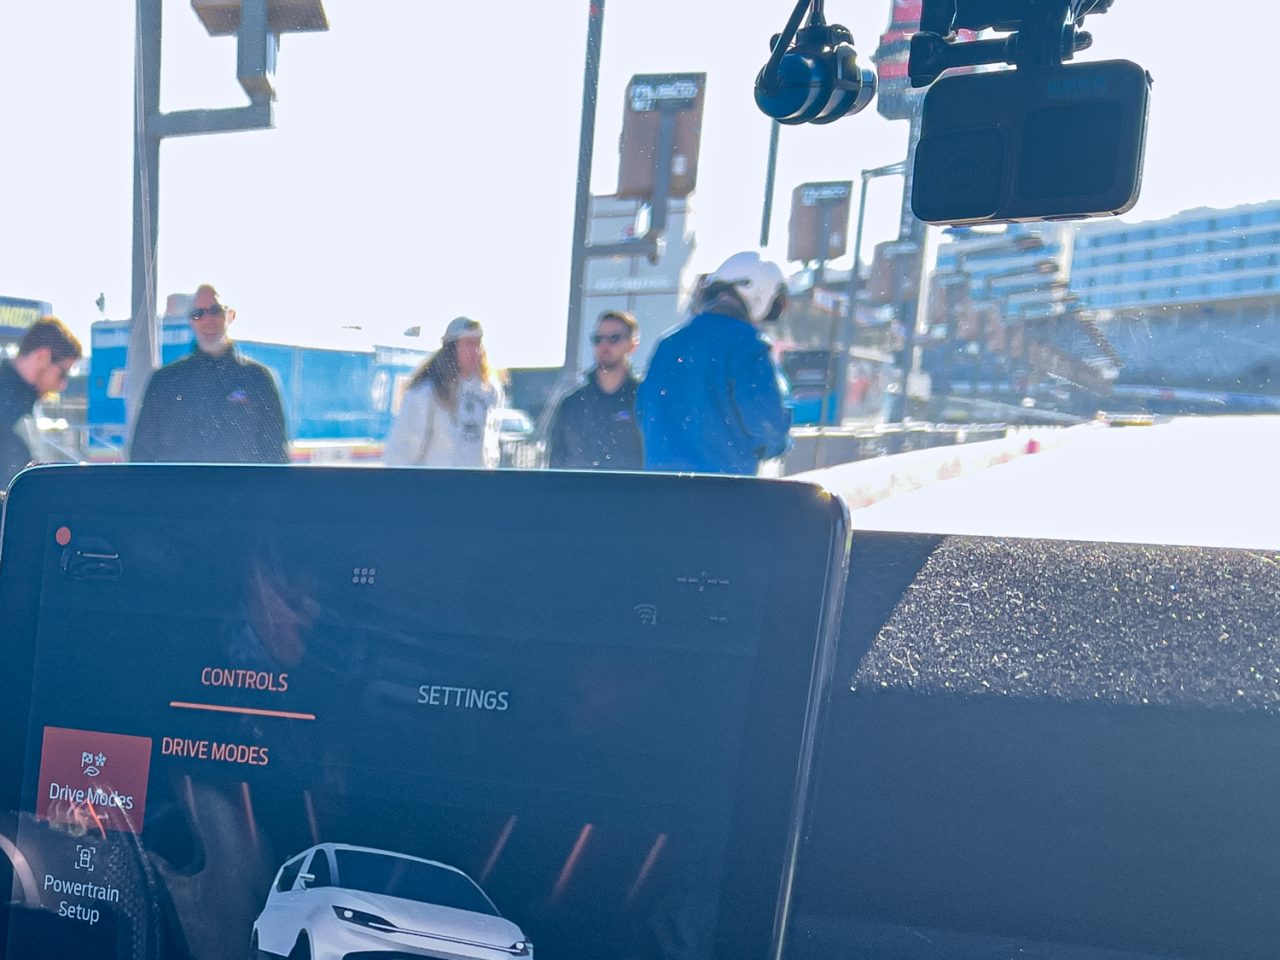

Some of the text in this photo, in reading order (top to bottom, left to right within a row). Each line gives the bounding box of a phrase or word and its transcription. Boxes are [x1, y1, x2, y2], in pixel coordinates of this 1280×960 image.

[200, 667, 289, 692] CONTROLS
[417, 684, 509, 711] SETTINGS
[161, 737, 270, 766] DRIVE MODES
[49, 782, 134, 810] Drive Modes
[43, 874, 120, 903] Powertrain
[58, 901, 100, 925] Setup
